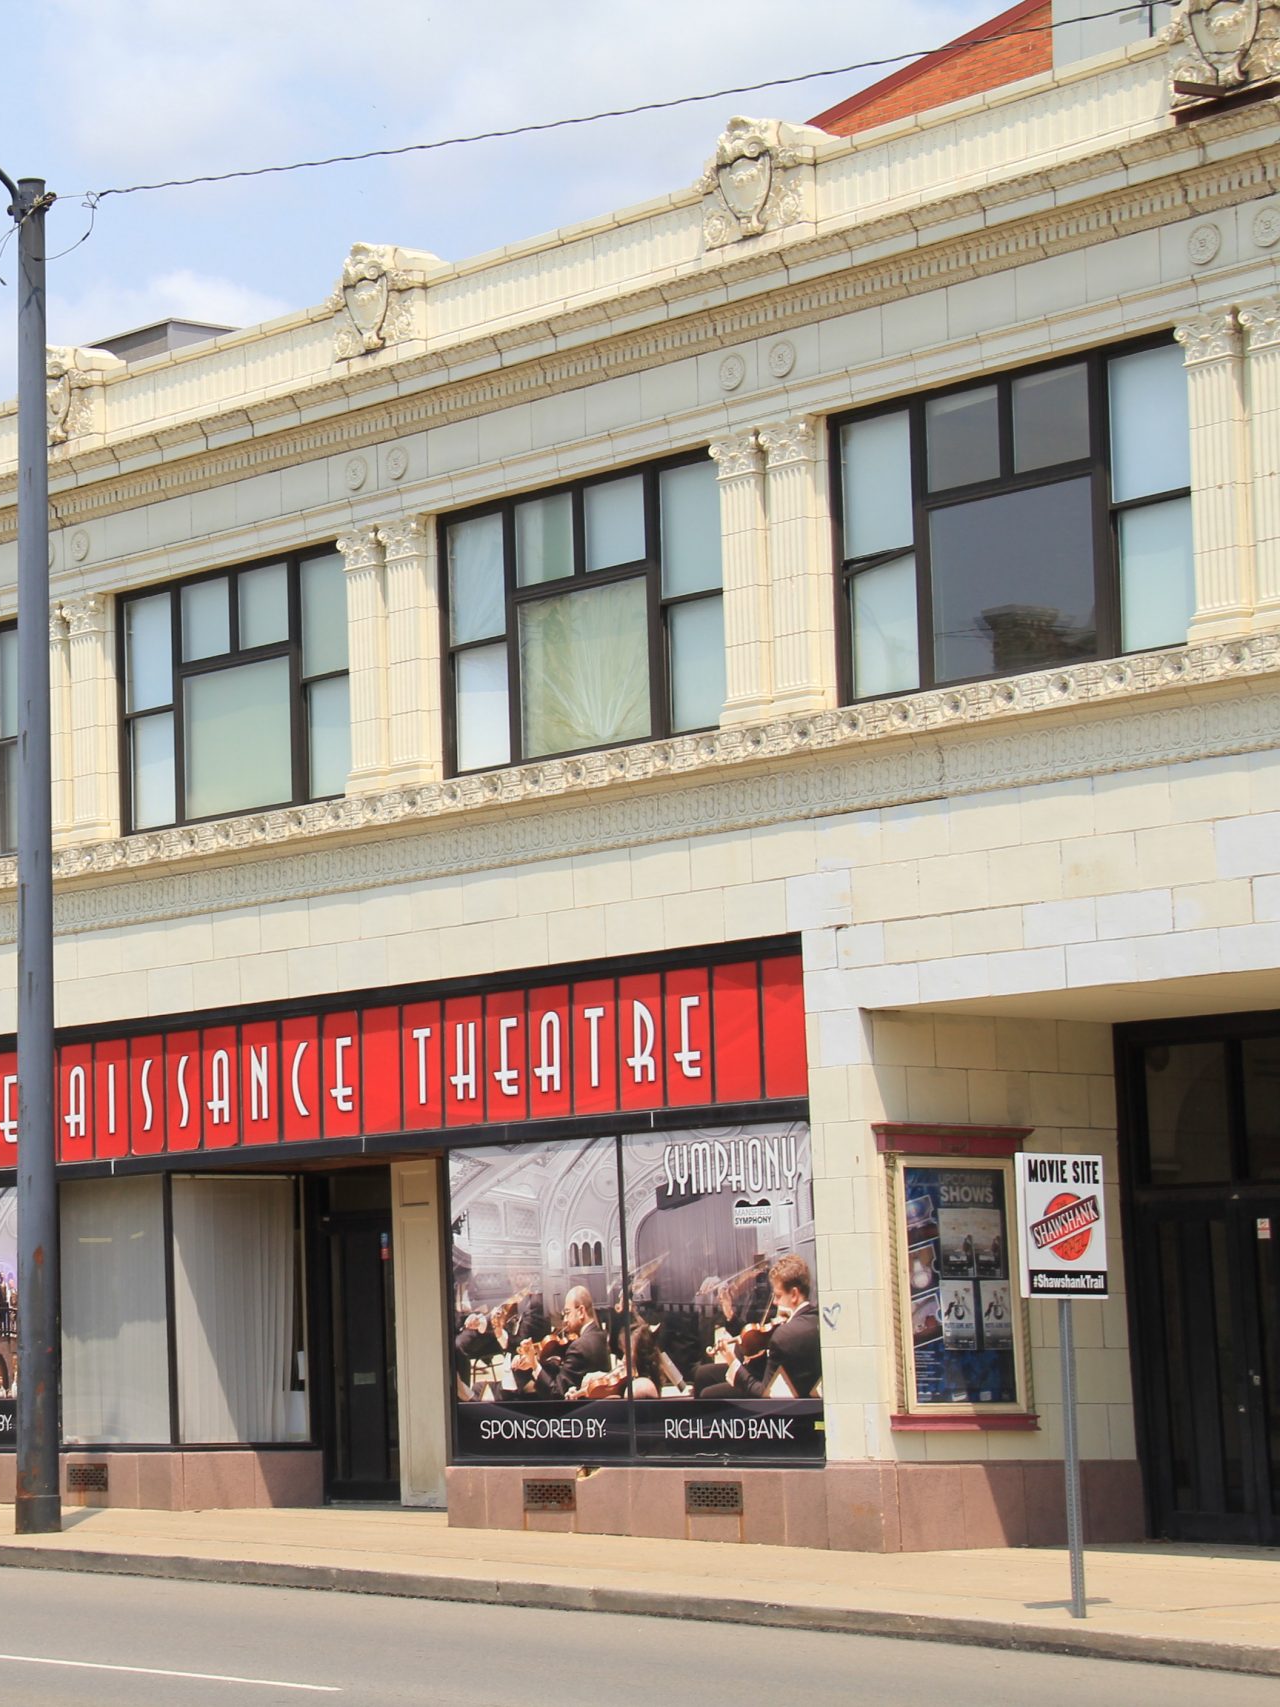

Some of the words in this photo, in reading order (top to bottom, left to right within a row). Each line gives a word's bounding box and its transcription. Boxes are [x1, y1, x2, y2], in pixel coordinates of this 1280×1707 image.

[412, 995, 702, 1105] THEATRE
[664, 1136, 797, 1196] SYMPHONY
[1028, 1159, 1068, 1184] MOVIE
[1072, 1160, 1100, 1185] SITE
[940, 1185, 994, 1204] SHOWS
[734, 1207, 772, 1216] MANSFIELD
[734, 1215, 772, 1225] SYMPHONY
[1033, 1200, 1099, 1248] SHAWSHANK
[1033, 1273, 1105, 1289] #ShawshankTrail
[479, 1418, 584, 1440] SPONSORED
[586, 1418, 608, 1438] BY:
[664, 1418, 746, 1439] RICHLAND
[748, 1418, 795, 1439] BANK
